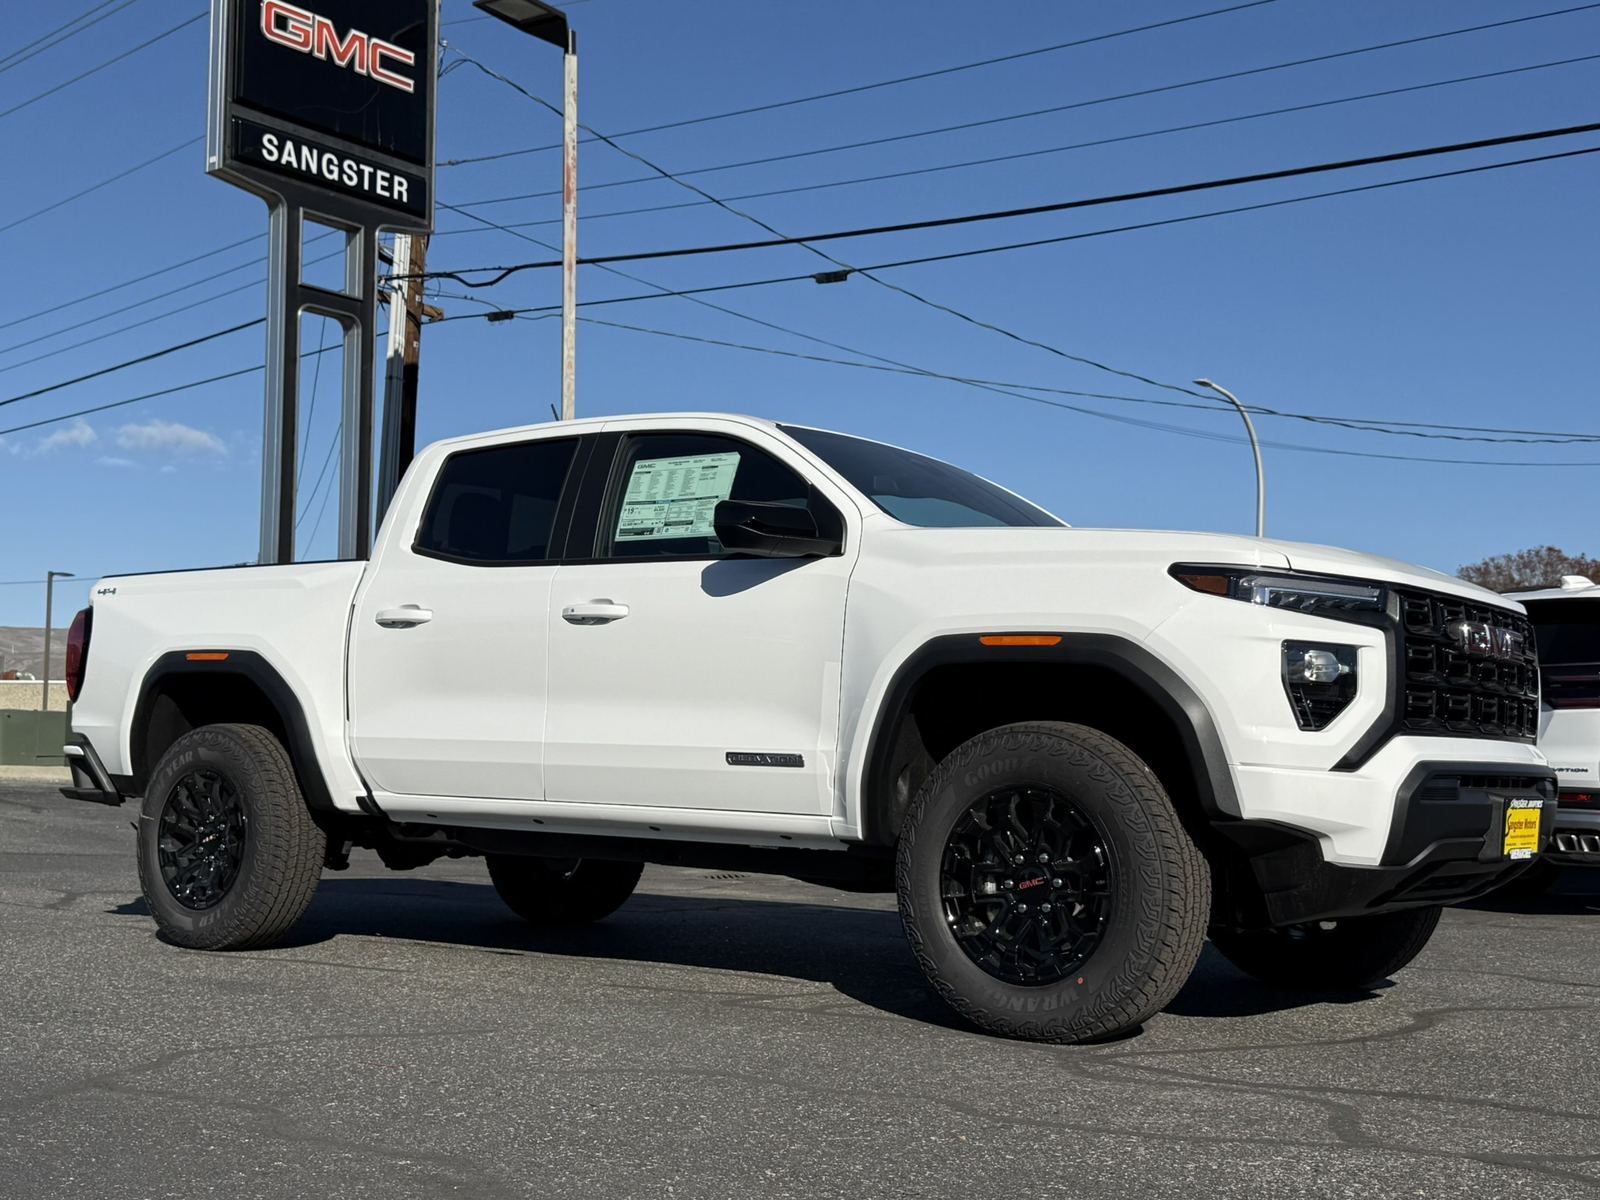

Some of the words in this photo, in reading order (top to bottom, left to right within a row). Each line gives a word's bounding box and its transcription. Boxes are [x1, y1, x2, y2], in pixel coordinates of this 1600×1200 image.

[261, 0, 415, 93] GMC
[261, 133, 409, 203] SANGSTER
[1019, 877, 1044, 889] GMC
